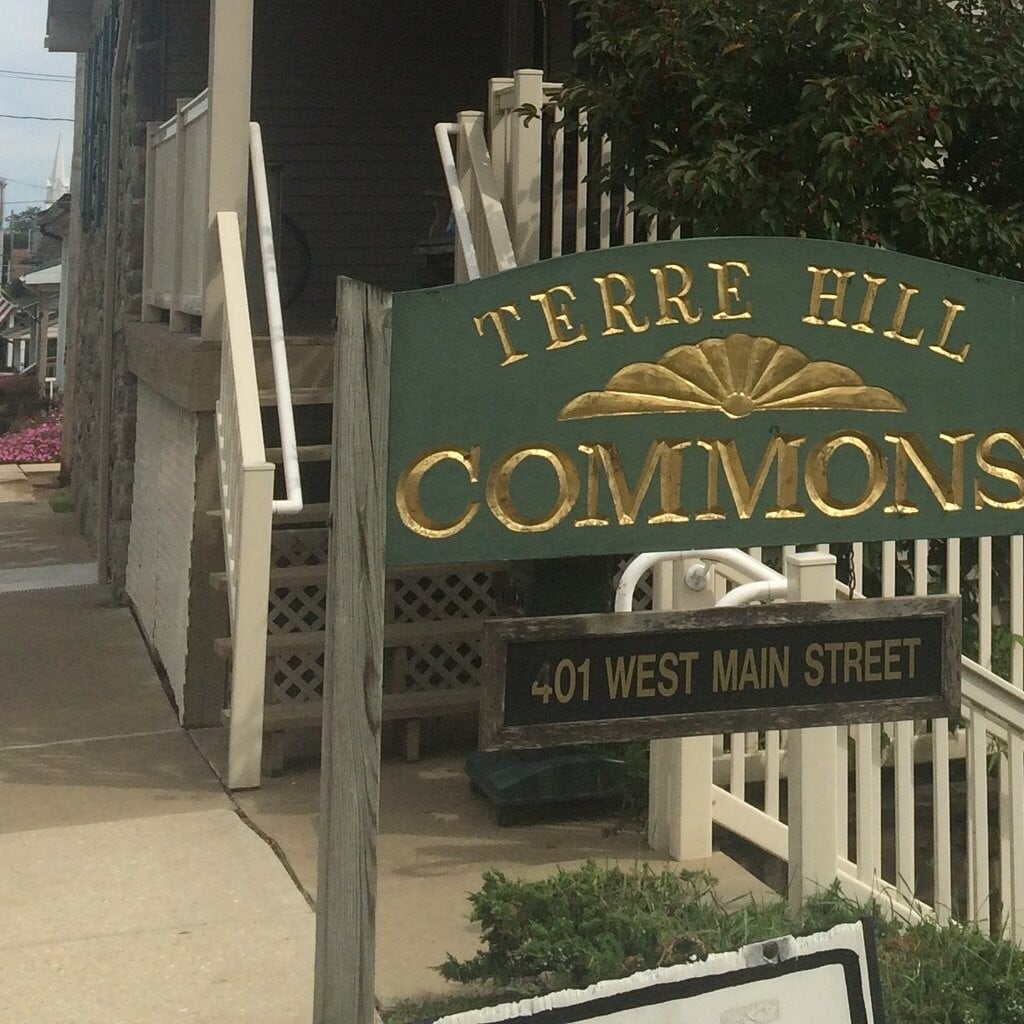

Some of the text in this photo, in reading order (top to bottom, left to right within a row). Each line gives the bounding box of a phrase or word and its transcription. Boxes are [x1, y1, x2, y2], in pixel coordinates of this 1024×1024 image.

[474, 261, 971, 367] TERRE HILL
[605, 652, 699, 699] WEST
[712, 646, 790, 692] MAIN
[804, 638, 921, 687] STREET
